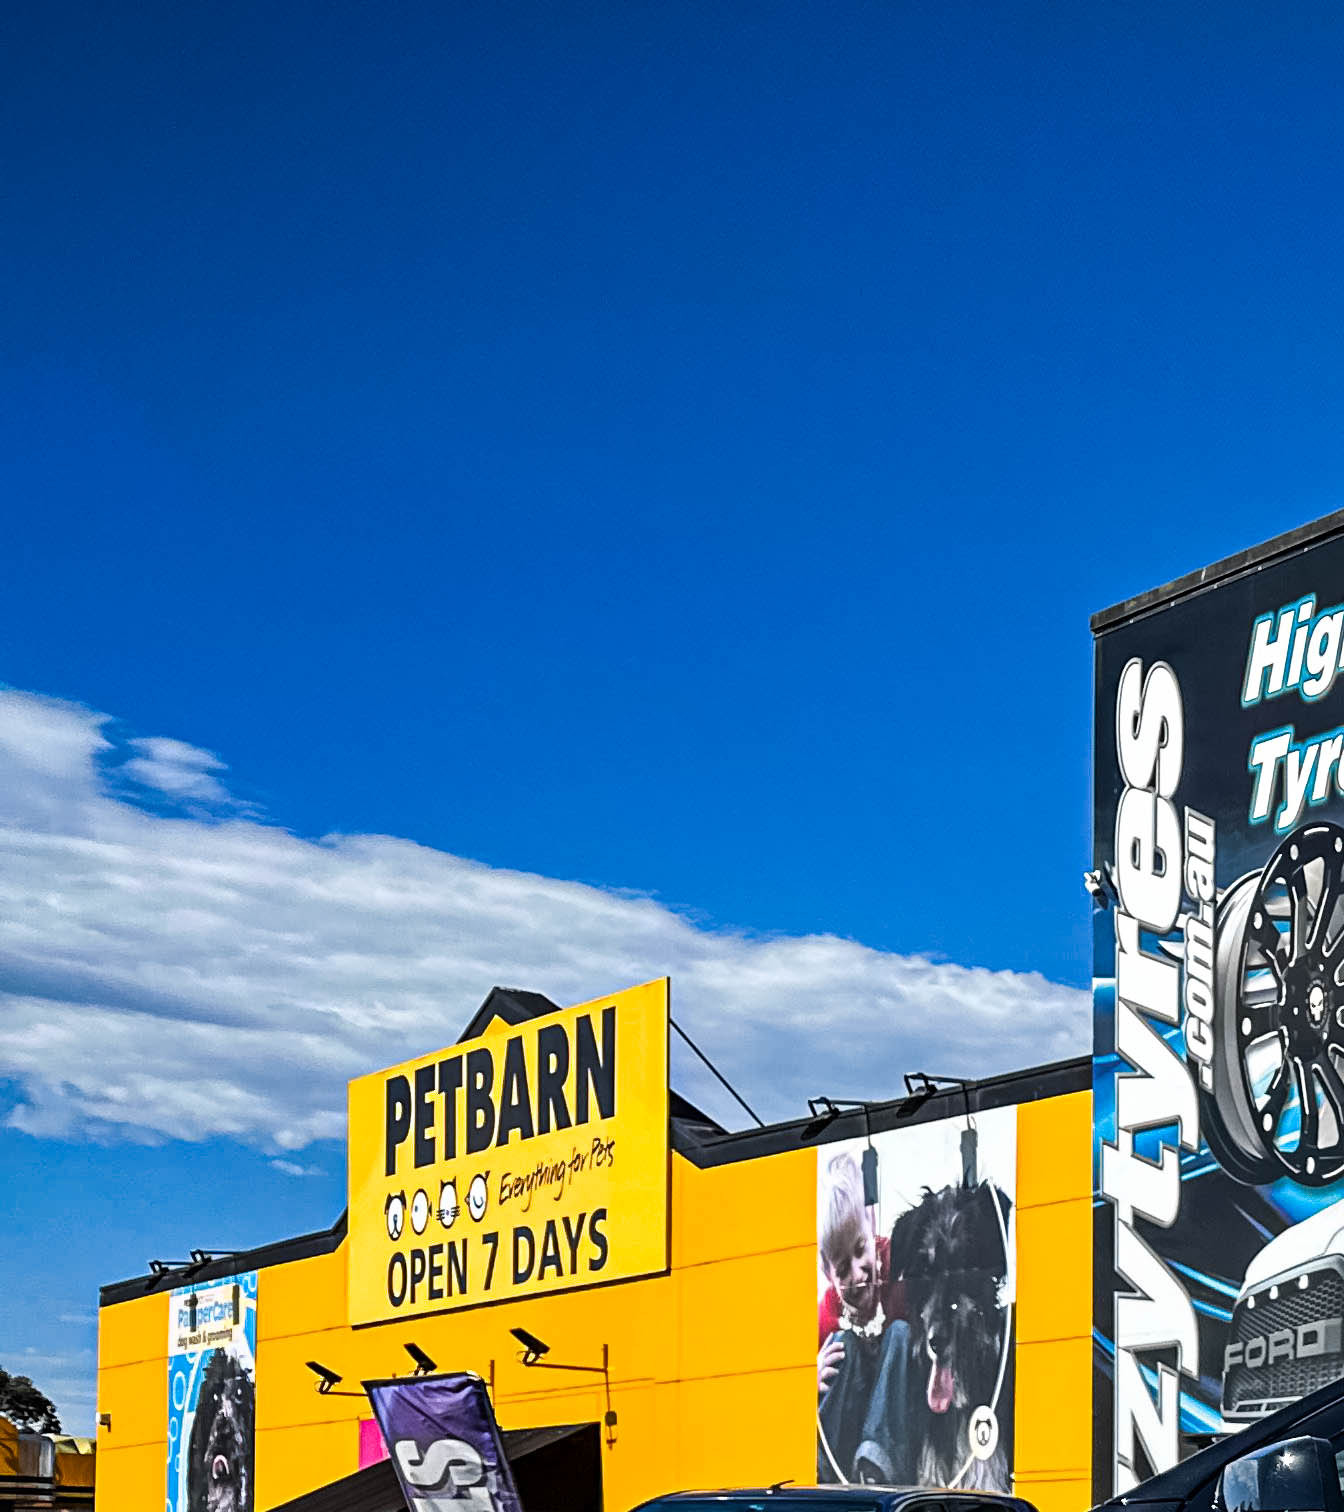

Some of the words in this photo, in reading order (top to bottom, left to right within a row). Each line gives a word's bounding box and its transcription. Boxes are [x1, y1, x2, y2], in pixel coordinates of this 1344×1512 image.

[385, 1006, 617, 1177] PETBARN
[1100, 656, 1200, 1498] zytyres
[498, 1159, 566, 1212] Everything
[568, 1146, 589, 1185] for
[589, 1136, 615, 1170] Pets
[387, 1237, 467, 1307] OPEN
[481, 1231, 499, 1290] 7
[512, 1208, 608, 1284] DAYS
[1224, 1318, 1326, 1372] FORD
